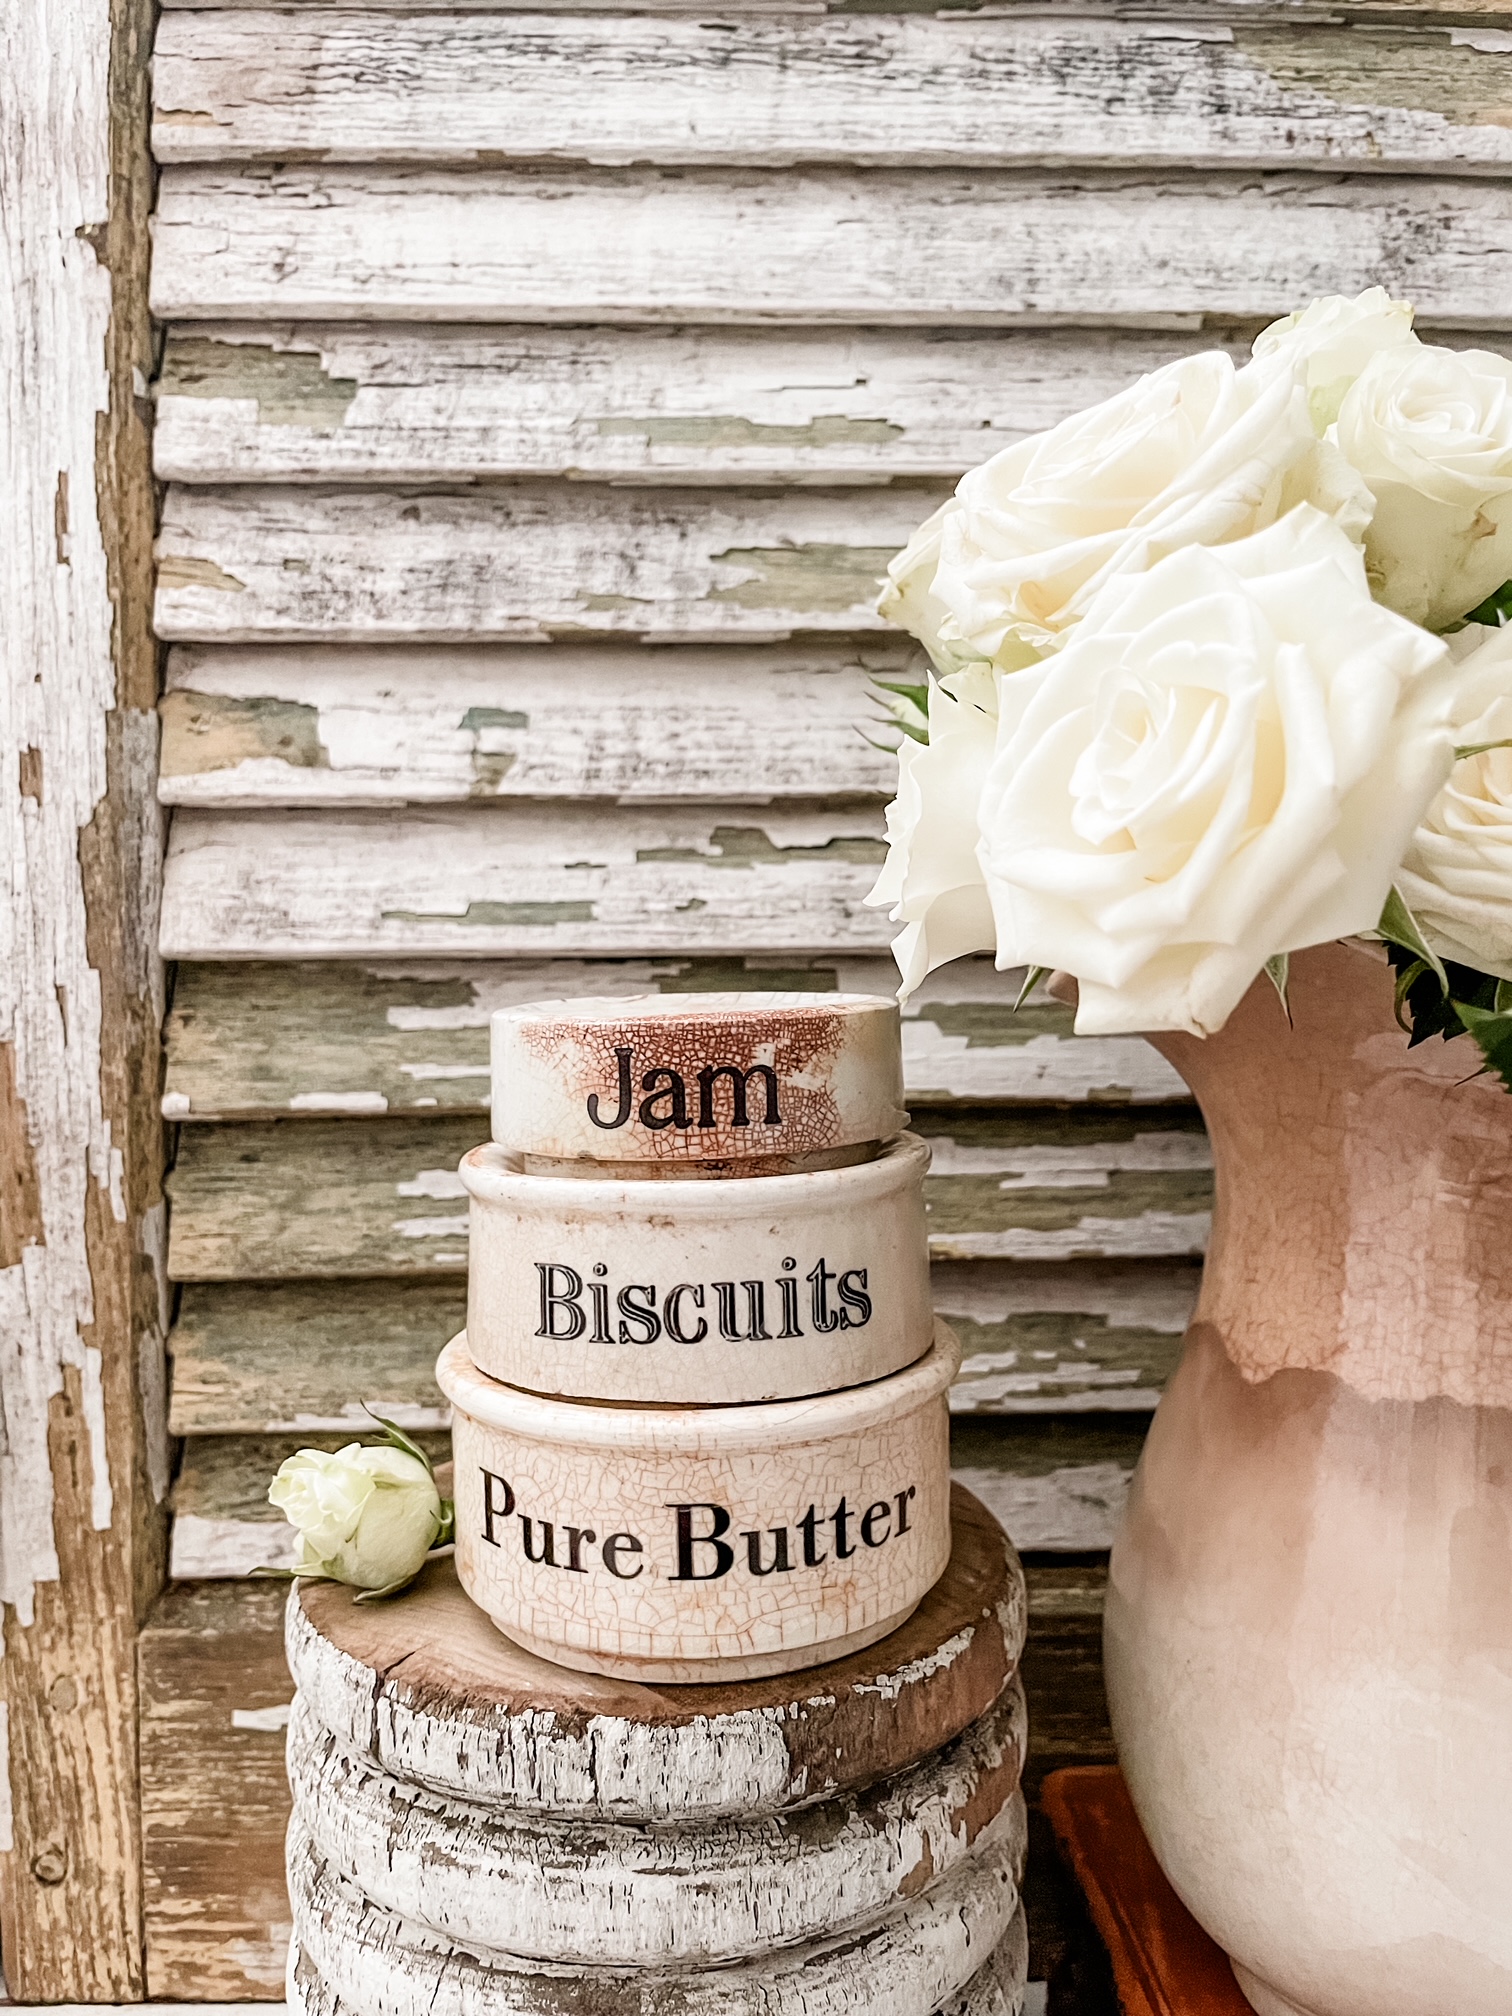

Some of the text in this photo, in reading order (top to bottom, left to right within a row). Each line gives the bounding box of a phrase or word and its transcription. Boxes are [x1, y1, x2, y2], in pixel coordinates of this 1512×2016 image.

[586, 1046, 783, 1131] Jam
[533, 1256, 873, 1345] Biscuits
[478, 1466, 917, 1582] Pure Butter
